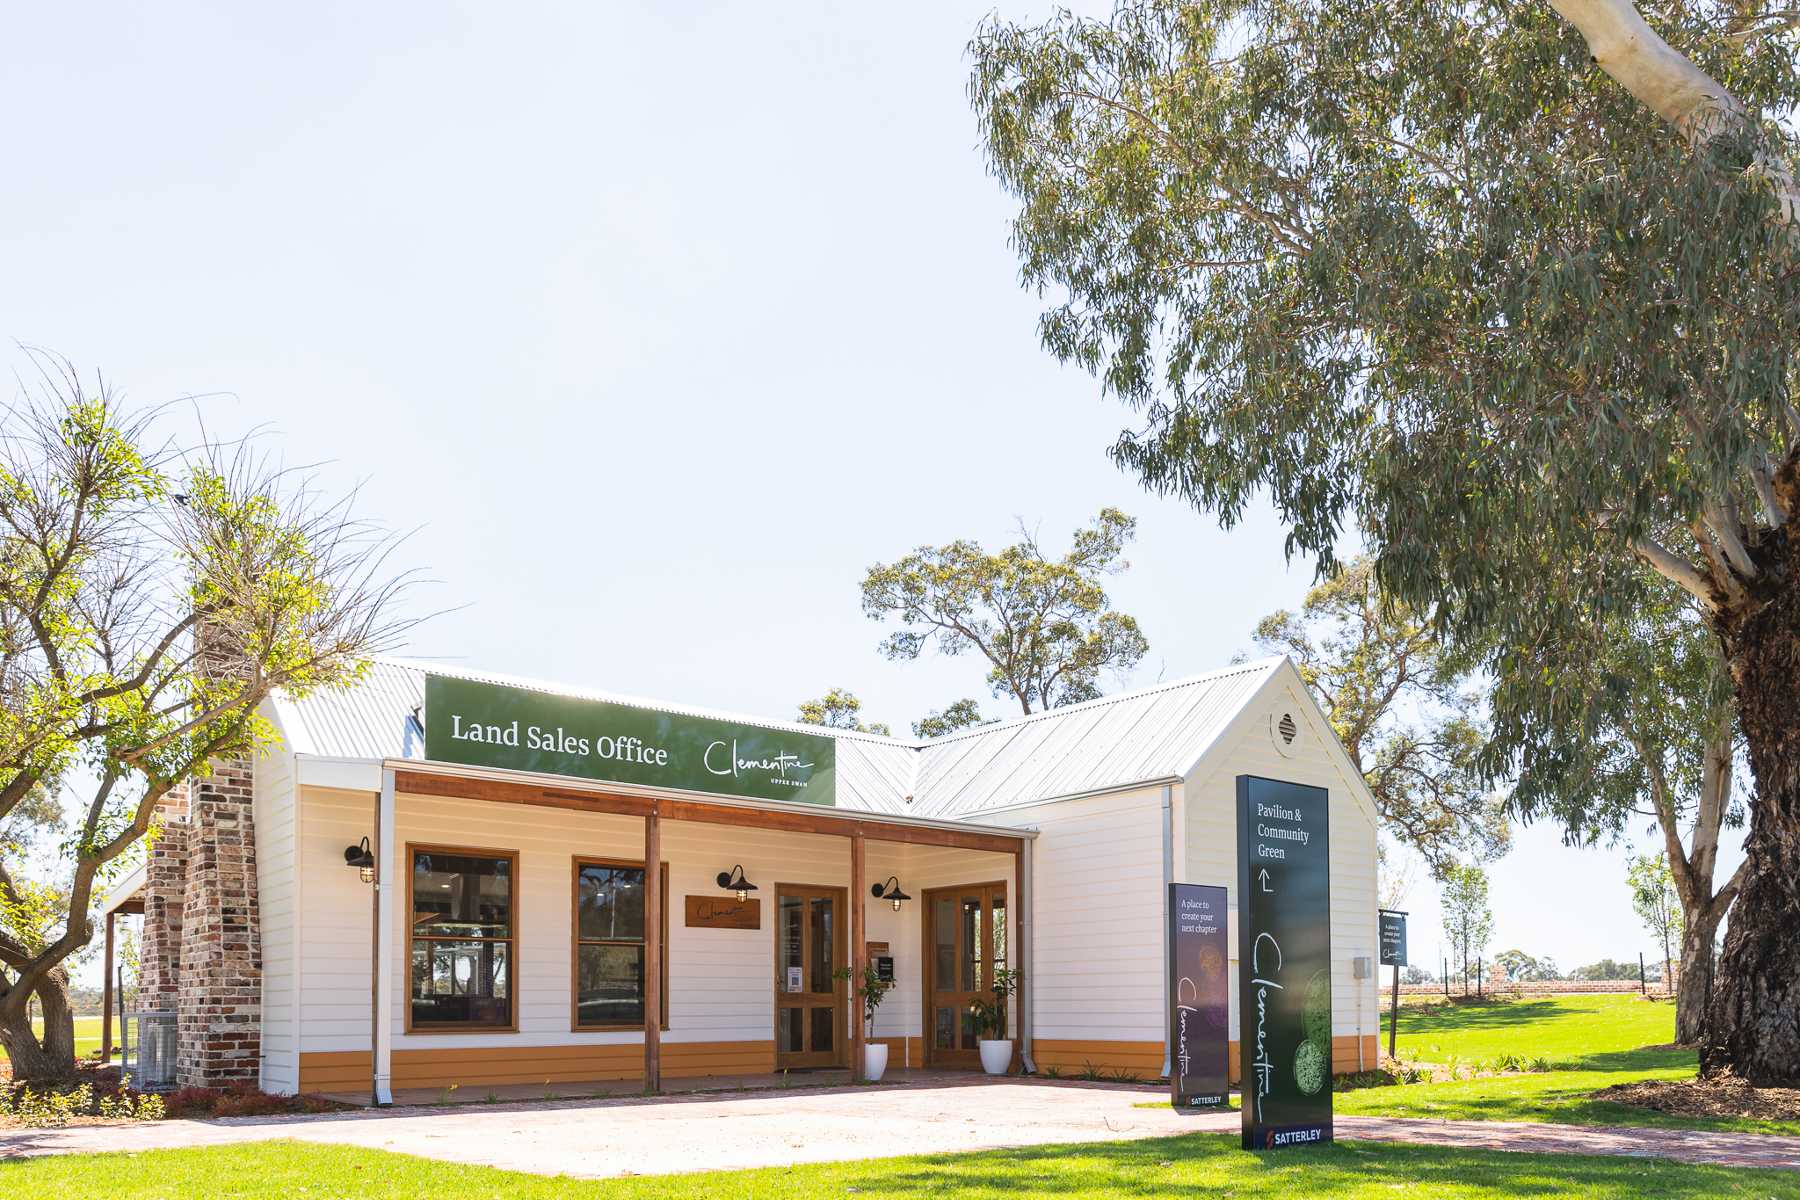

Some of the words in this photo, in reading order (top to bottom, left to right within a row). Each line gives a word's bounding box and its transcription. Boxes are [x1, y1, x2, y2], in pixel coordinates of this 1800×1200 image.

[451, 714, 520, 747] Land
[527, 726, 590, 756] Sales
[596, 735, 668, 766] Office
[703, 738, 815, 778] Clementine
[1257, 802, 1294, 821] Pavilion
[1294, 808, 1302, 822] &
[1257, 823, 1310, 846] Community
[1258, 843, 1286, 859] Green
[1181, 899, 1187, 909] A
[1186, 899, 1202, 911] place
[1201, 901, 1210, 909] to
[1181, 912, 1199, 921] create
[1199, 914, 1214, 923] your
[1181, 924, 1195, 933] next
[1195, 923, 1217, 935] chapter
[1176, 976, 1199, 1094] Clementine
[1251, 932, 1284, 1124] Clementine
[1191, 1095, 1222, 1106] SATTERLEY
[1274, 1128, 1321, 1145] SATTERLEY
